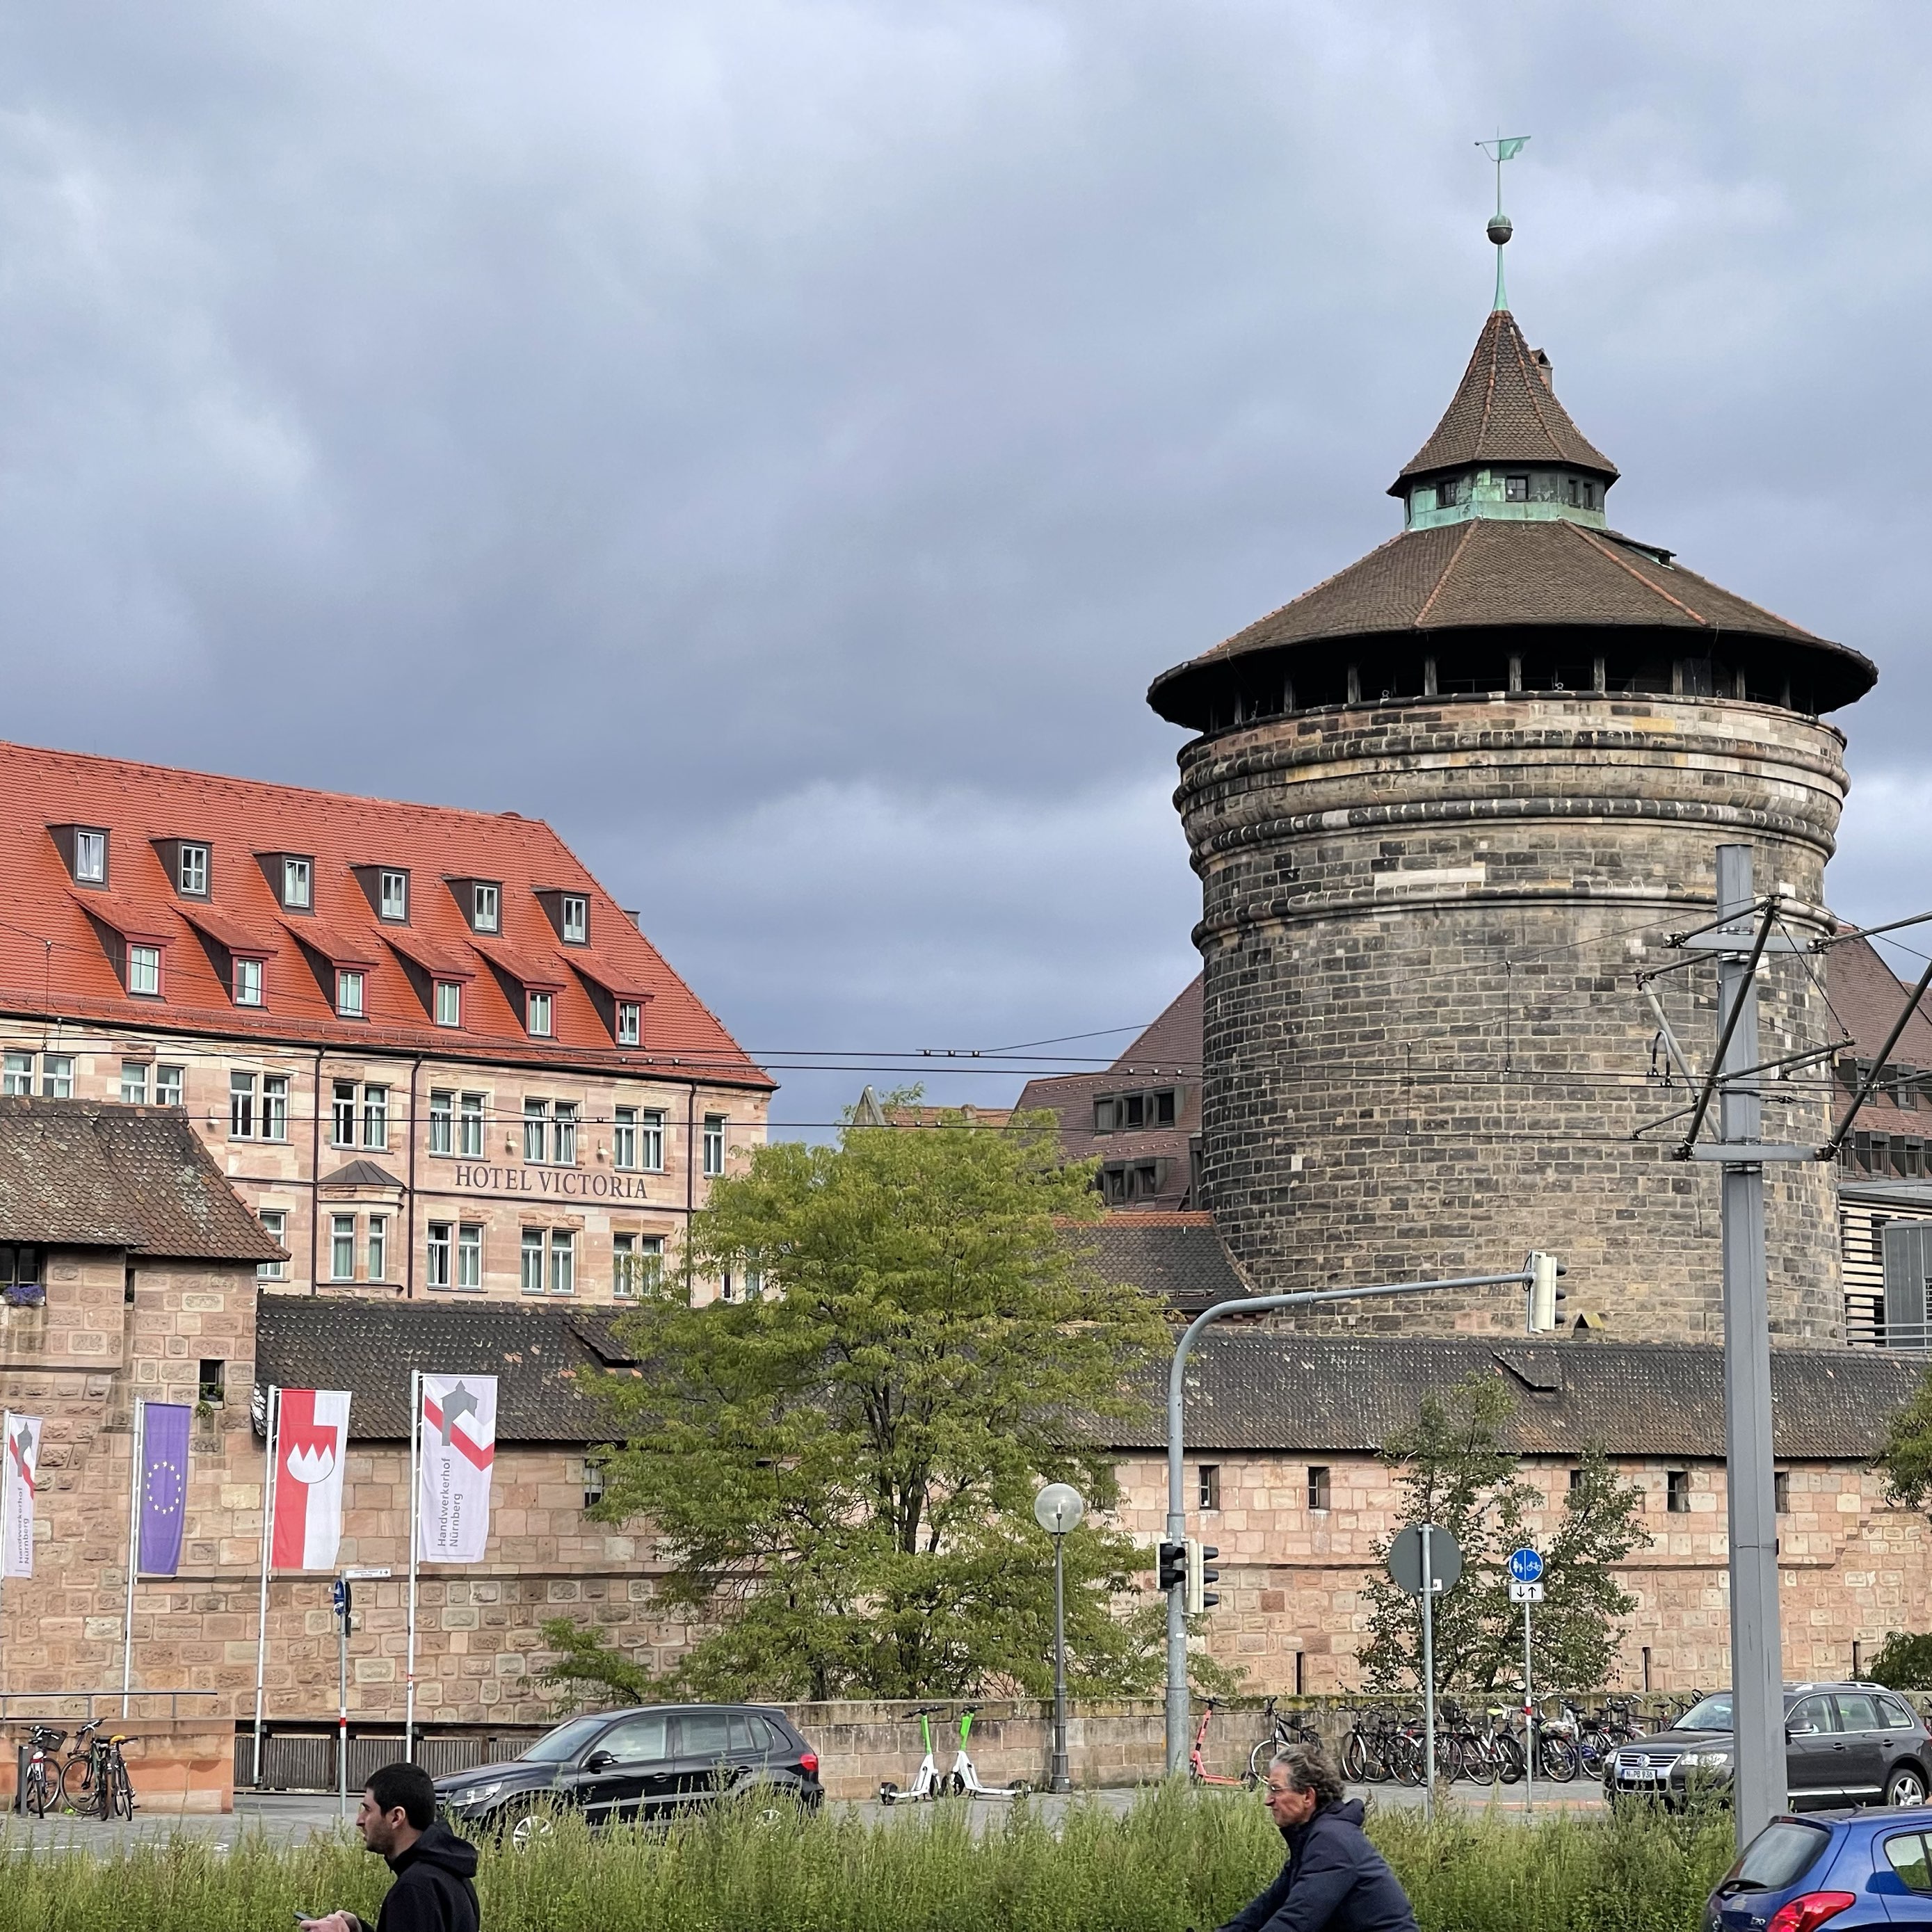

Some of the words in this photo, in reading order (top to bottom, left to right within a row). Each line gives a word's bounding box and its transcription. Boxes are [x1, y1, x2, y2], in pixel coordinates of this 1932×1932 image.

[456, 1165, 532, 1191] HOTEL
[538, 1171, 647, 1199] VICTORIA
[437, 1458, 450, 1547] Handwerkerhof
[449, 1493, 463, 1547] Nürnberg
